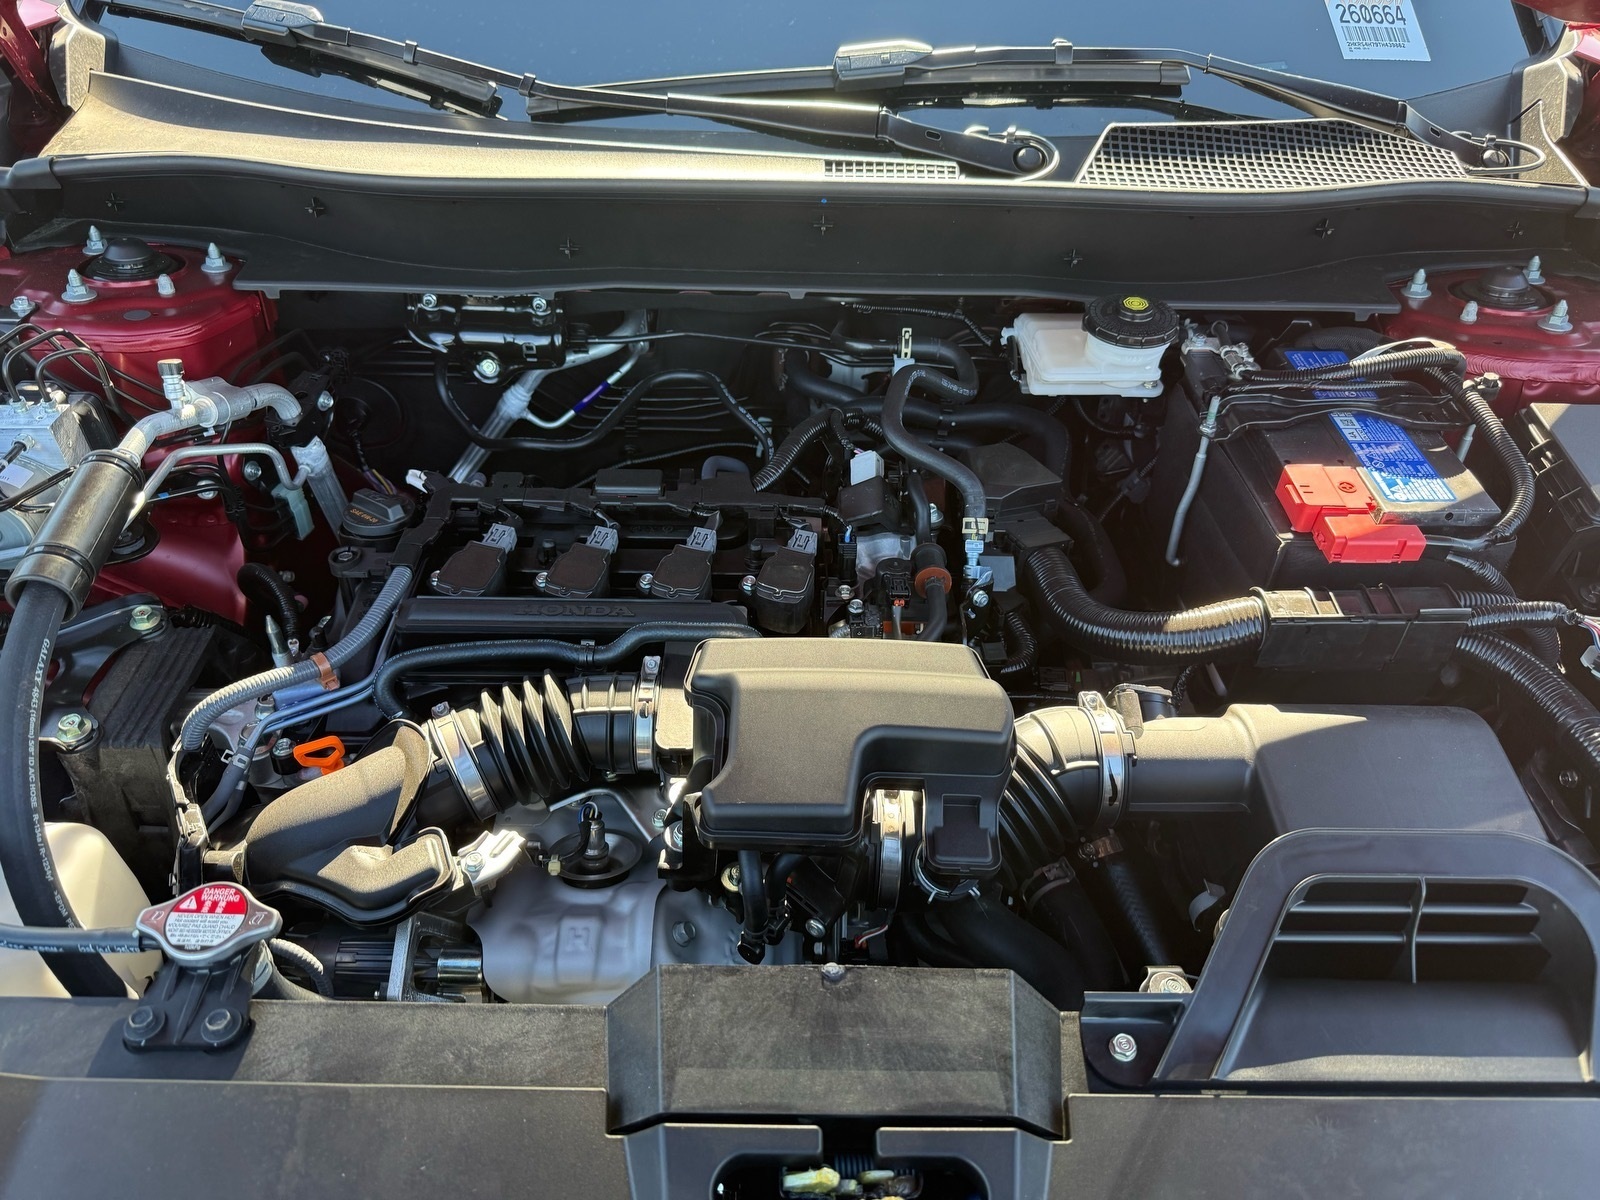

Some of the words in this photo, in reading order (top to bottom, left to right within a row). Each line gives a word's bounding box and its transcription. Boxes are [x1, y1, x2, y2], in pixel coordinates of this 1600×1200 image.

[1335, 3, 1406, 25] 260664
[513, 604, 635, 617] HONDA
[34, 638, 50, 686] GALAXY
[31, 686, 39, 709] 4843
[28, 709, 37, 738] (16mm)
[28, 757, 35, 766] ID
[29, 784, 38, 808] HOSE
[32, 814, 42, 842] R-134a
[201, 893, 240, 902] WARNUNG
